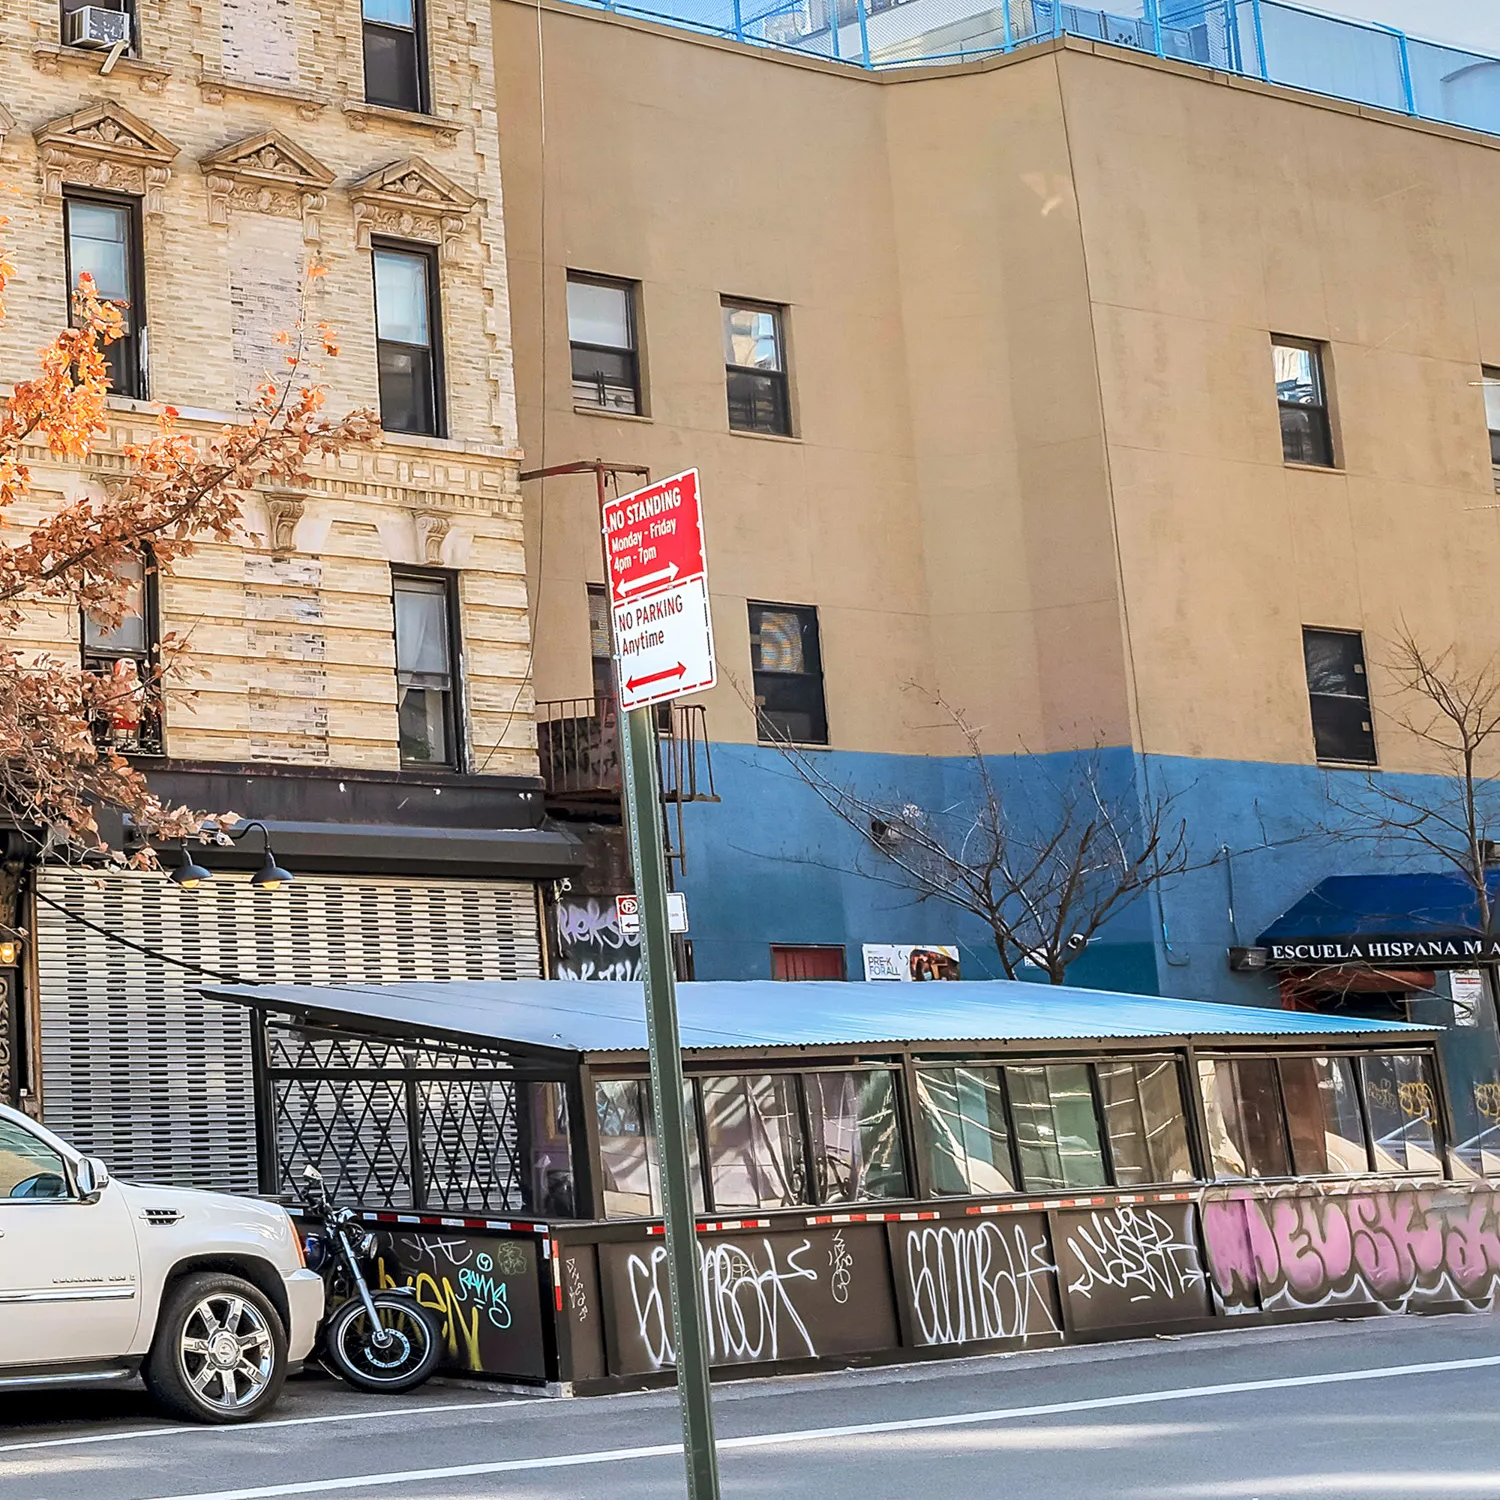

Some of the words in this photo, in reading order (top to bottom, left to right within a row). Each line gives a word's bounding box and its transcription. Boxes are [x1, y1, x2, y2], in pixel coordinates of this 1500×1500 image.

[609, 509, 624, 532] NO
[626, 487, 681, 526] STANDING
[612, 532, 642, 554] Monday
[650, 518, 677, 540] Friday
[614, 555, 632, 575] 4pm
[638, 545, 657, 567] 7pm
[618, 612, 633, 632] NO
[636, 594, 683, 627] PARKING
[622, 629, 665, 656] Anytime
[868, 956, 893, 966] PRE-K
[1273, 944, 1362, 959] ESCUELA
[1368, 941, 1458, 957] HISPANA
